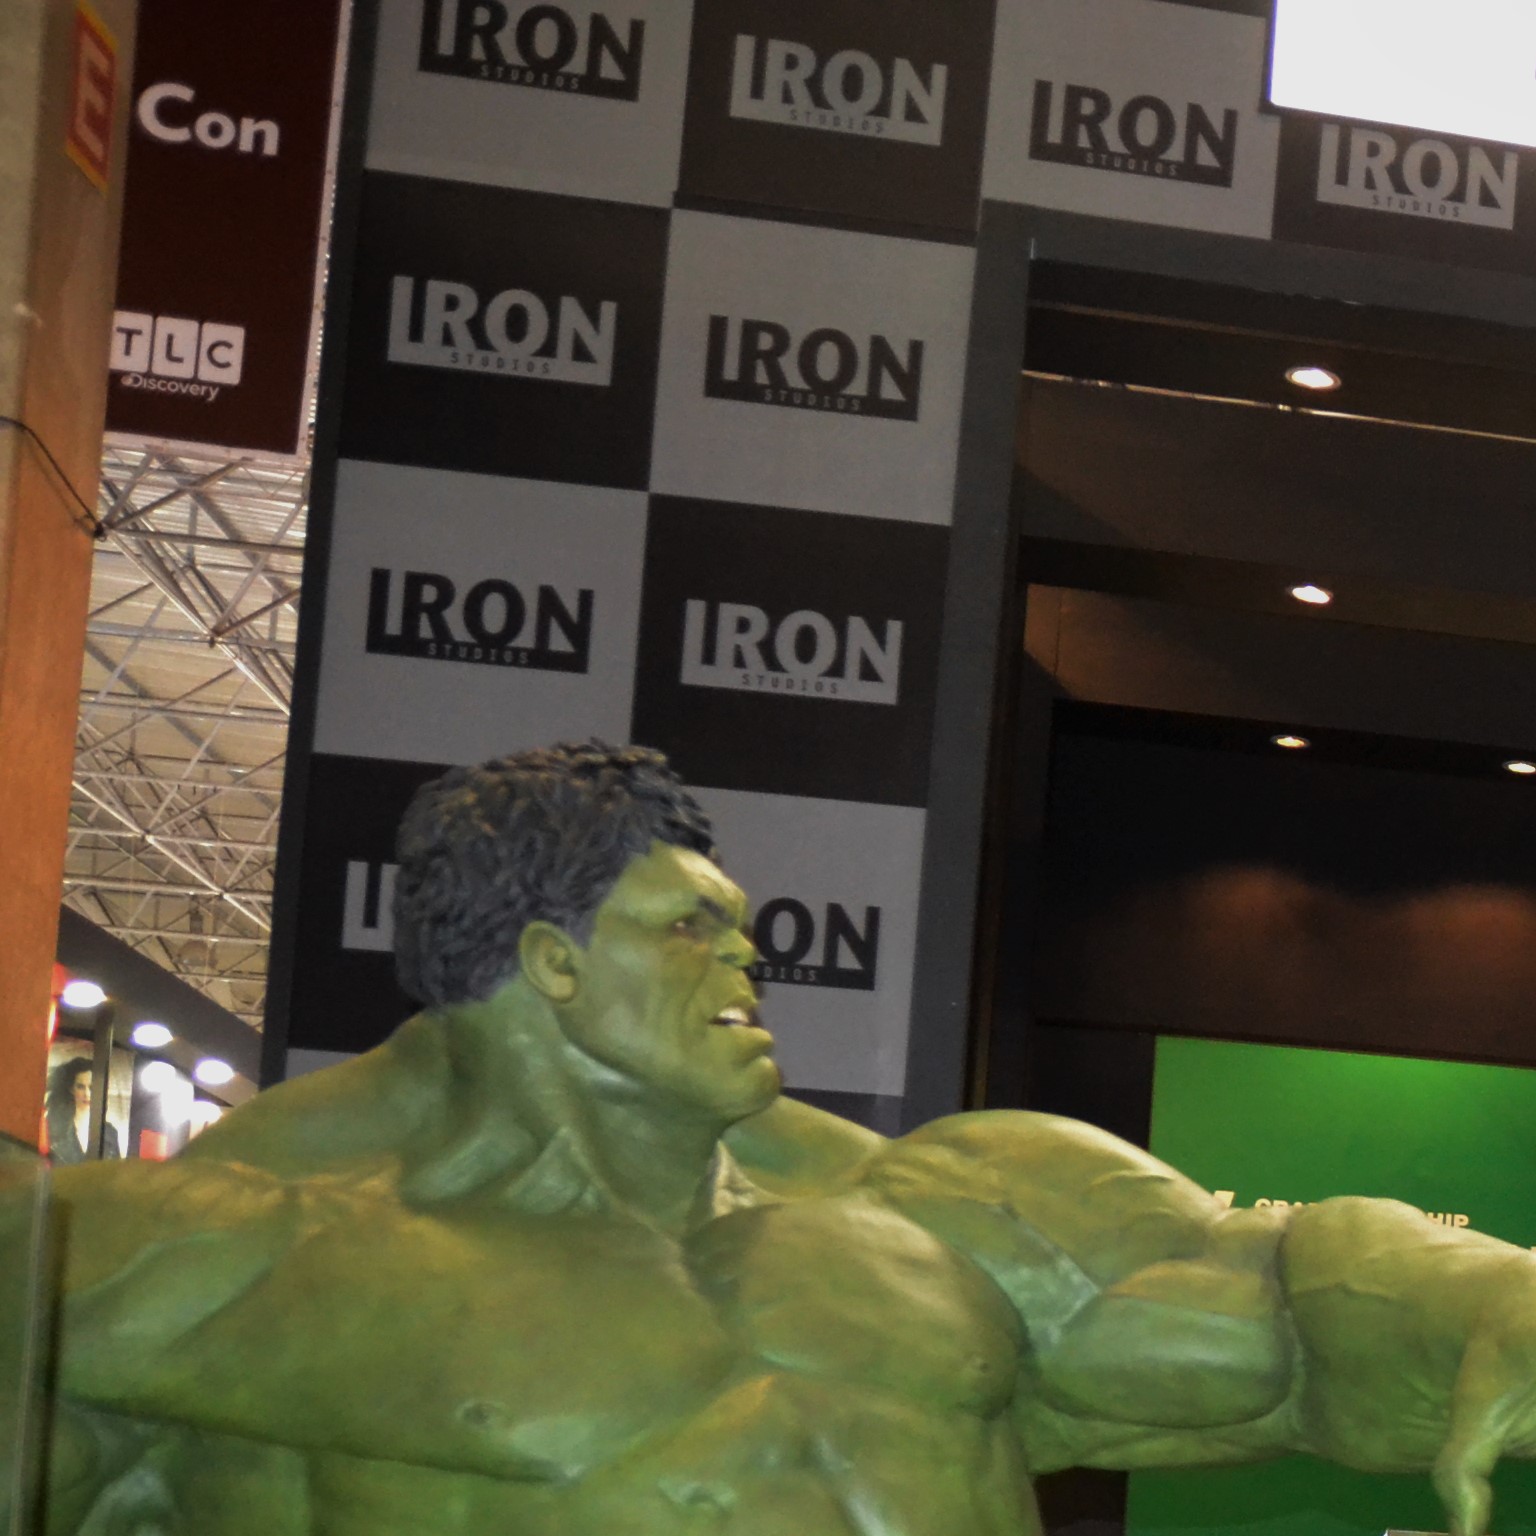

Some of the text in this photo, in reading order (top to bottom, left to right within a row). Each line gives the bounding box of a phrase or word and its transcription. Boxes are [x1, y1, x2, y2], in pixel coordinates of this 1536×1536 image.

[419, 0, 645, 85] IRON
[479, 64, 581, 91] STUDIOS
[731, 34, 948, 130] IRON
[137, 82, 281, 157] Con
[788, 108, 886, 135] STUDIOS
[1030, 79, 1237, 172] IRON
[1084, 151, 1178, 177] STUDIOS
[1318, 124, 1518, 215] IRON
[1371, 194, 1462, 220] STUDIOS
[114, 321, 236, 371] TLC
[389, 276, 617, 369] IRON
[121, 373, 220, 401] Discovery
[449, 351, 552, 376] STUDIOS
[705, 314, 923, 405] IRON
[763, 387, 862, 412] STUDIOS
[368, 568, 594, 657] IRON
[682, 599, 903, 688] IRON
[427, 642, 530, 665] STUDIOS
[740, 673, 840, 696] STUDIOS
[754, 897, 880, 972] ON
